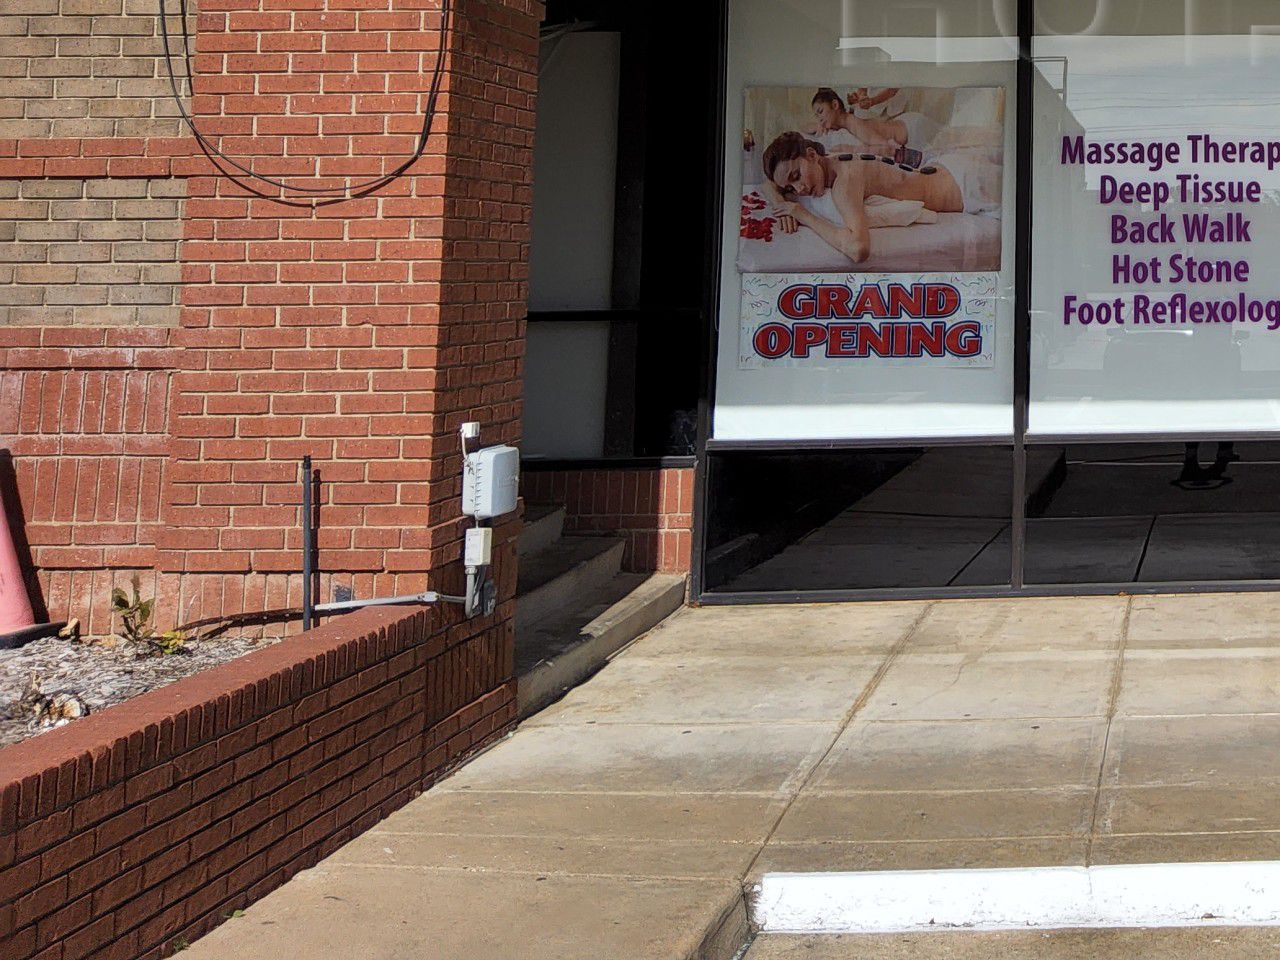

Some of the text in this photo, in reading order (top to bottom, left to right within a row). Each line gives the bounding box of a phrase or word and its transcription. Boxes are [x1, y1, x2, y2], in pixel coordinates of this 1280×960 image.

[1061, 135, 1180, 171] Massage
[1100, 173, 1262, 211] Deep Tissue
[1111, 212, 1252, 244] Back Walk
[1112, 253, 1250, 284] Hot Stone
[777, 282, 962, 320] GRAND
[1063, 295, 1126, 326] Foot
[752, 320, 983, 359] OPENING
